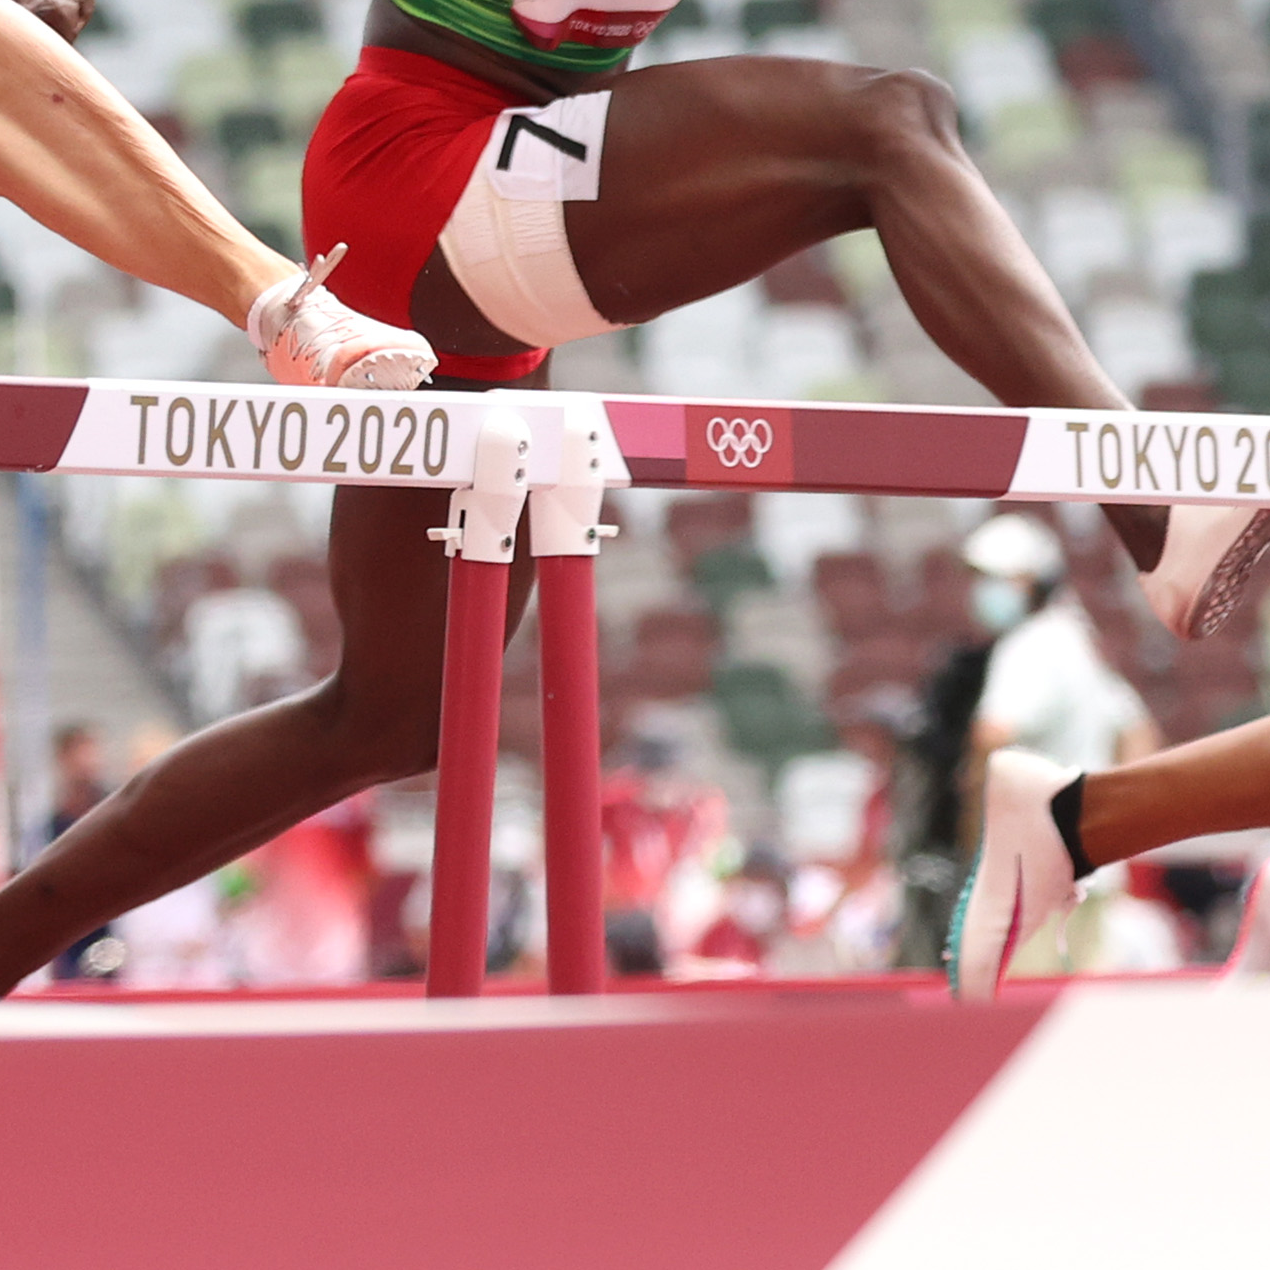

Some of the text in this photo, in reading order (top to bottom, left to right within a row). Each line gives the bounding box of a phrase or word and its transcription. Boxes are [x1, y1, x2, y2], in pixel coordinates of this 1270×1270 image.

[496, 114, 587, 171] 7
[130, 396, 450, 477] TOKYO 2020
[1066, 422, 1270, 494] TOKYO 2
